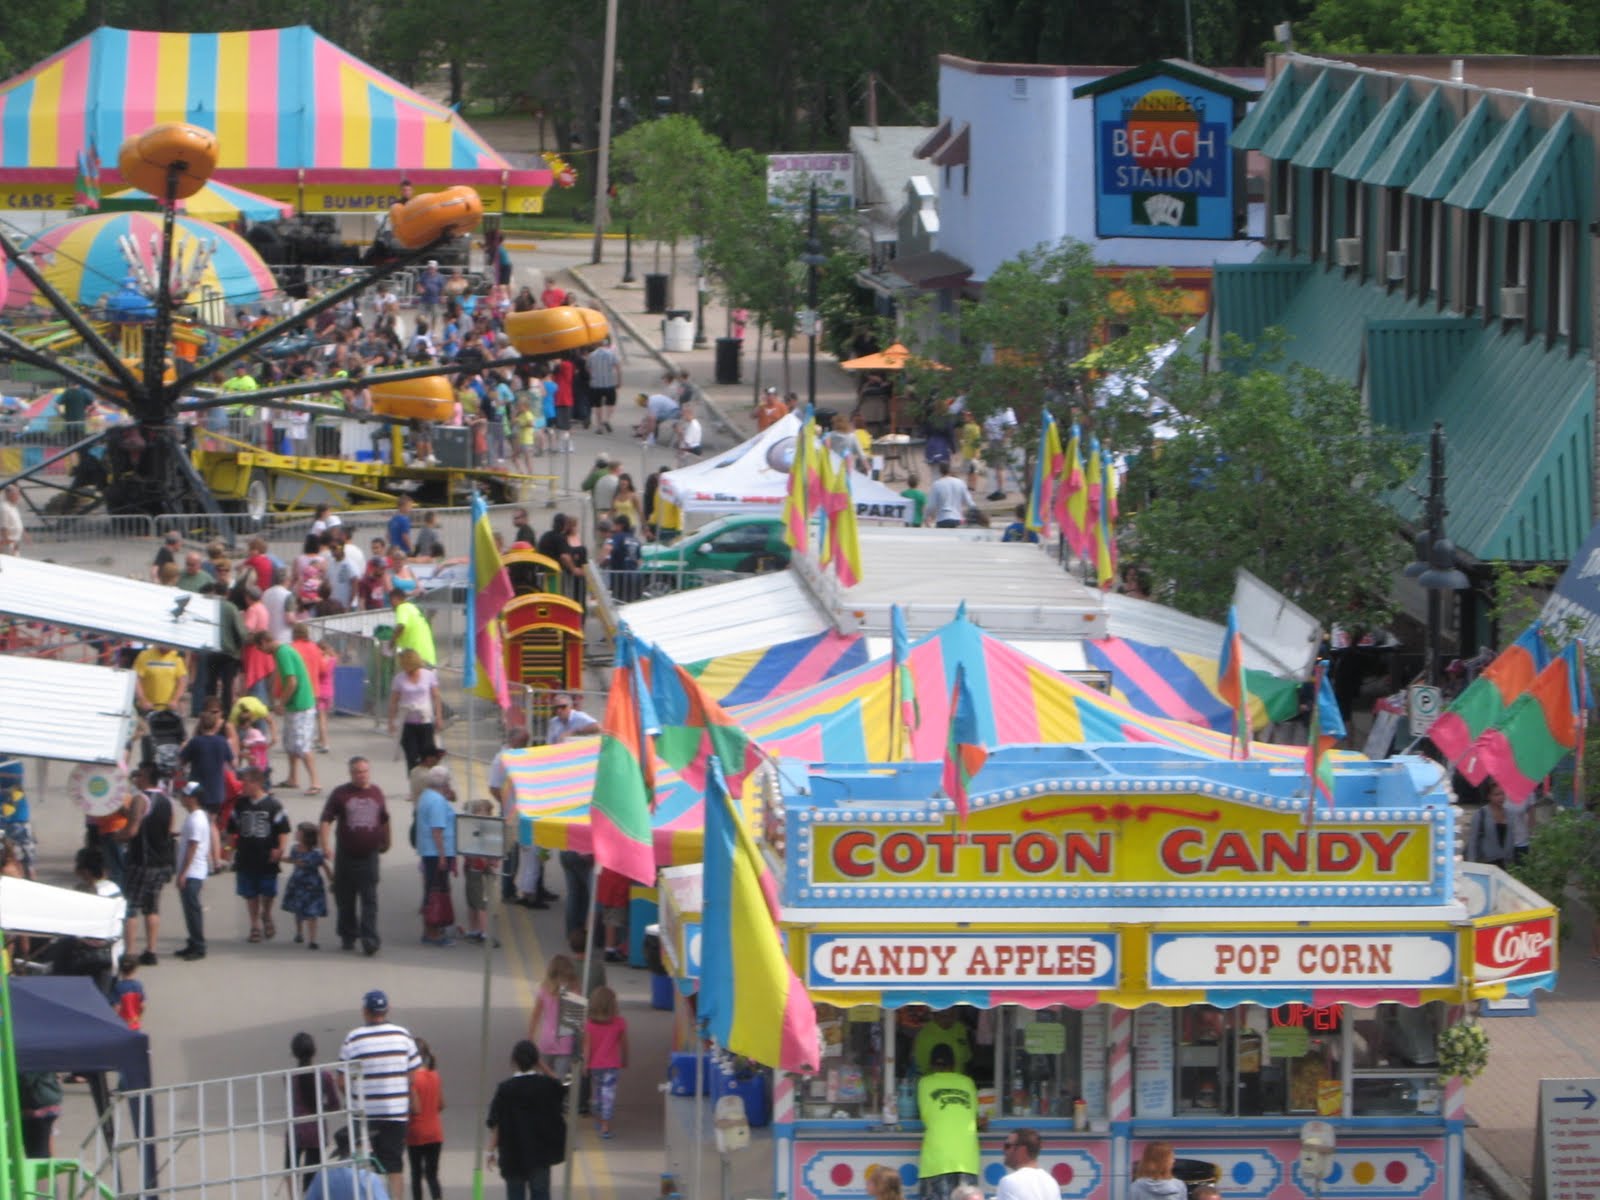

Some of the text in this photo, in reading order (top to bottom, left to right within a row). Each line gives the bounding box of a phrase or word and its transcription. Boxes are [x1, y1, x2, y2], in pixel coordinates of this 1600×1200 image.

[1112, 129, 1215, 159] BEACH
[1116, 165, 1213, 188] STATION
[8, 193, 56, 209] CARS
[856, 503, 907, 519] PART
[831, 827, 1413, 878] COTTON CANDY
[1214, 944, 1393, 975] POP CORN
[1492, 925, 1546, 964] Coke
[830, 945, 1097, 976] CANDY APPLES
